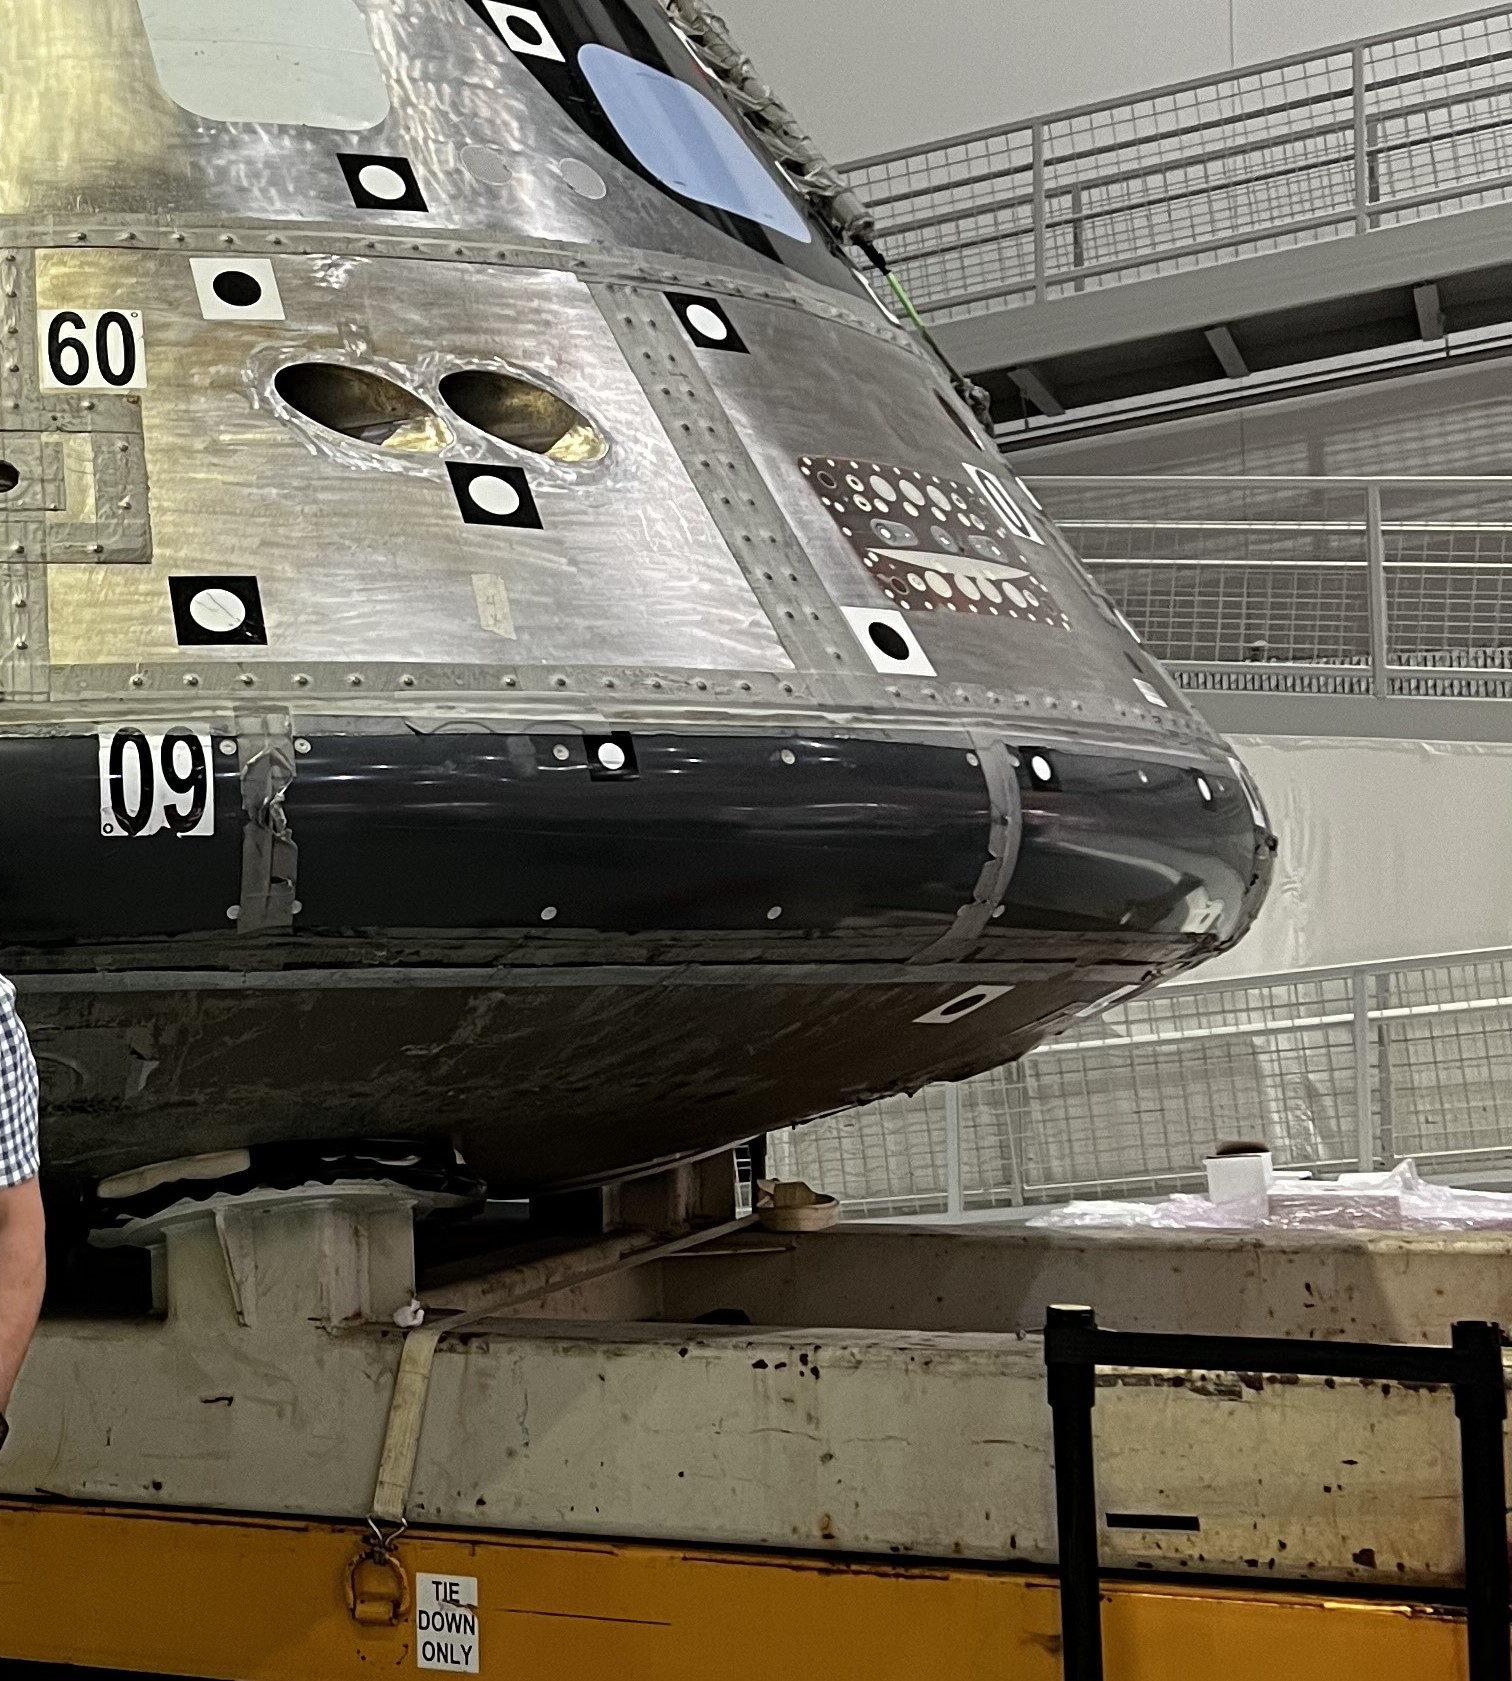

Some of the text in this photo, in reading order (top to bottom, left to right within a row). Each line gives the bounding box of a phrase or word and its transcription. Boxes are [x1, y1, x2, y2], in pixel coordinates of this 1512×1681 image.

[432, 1581, 459, 1603] TIE
[419, 1610, 475, 1635] DOWN
[422, 1641, 472, 1665] ONLY
